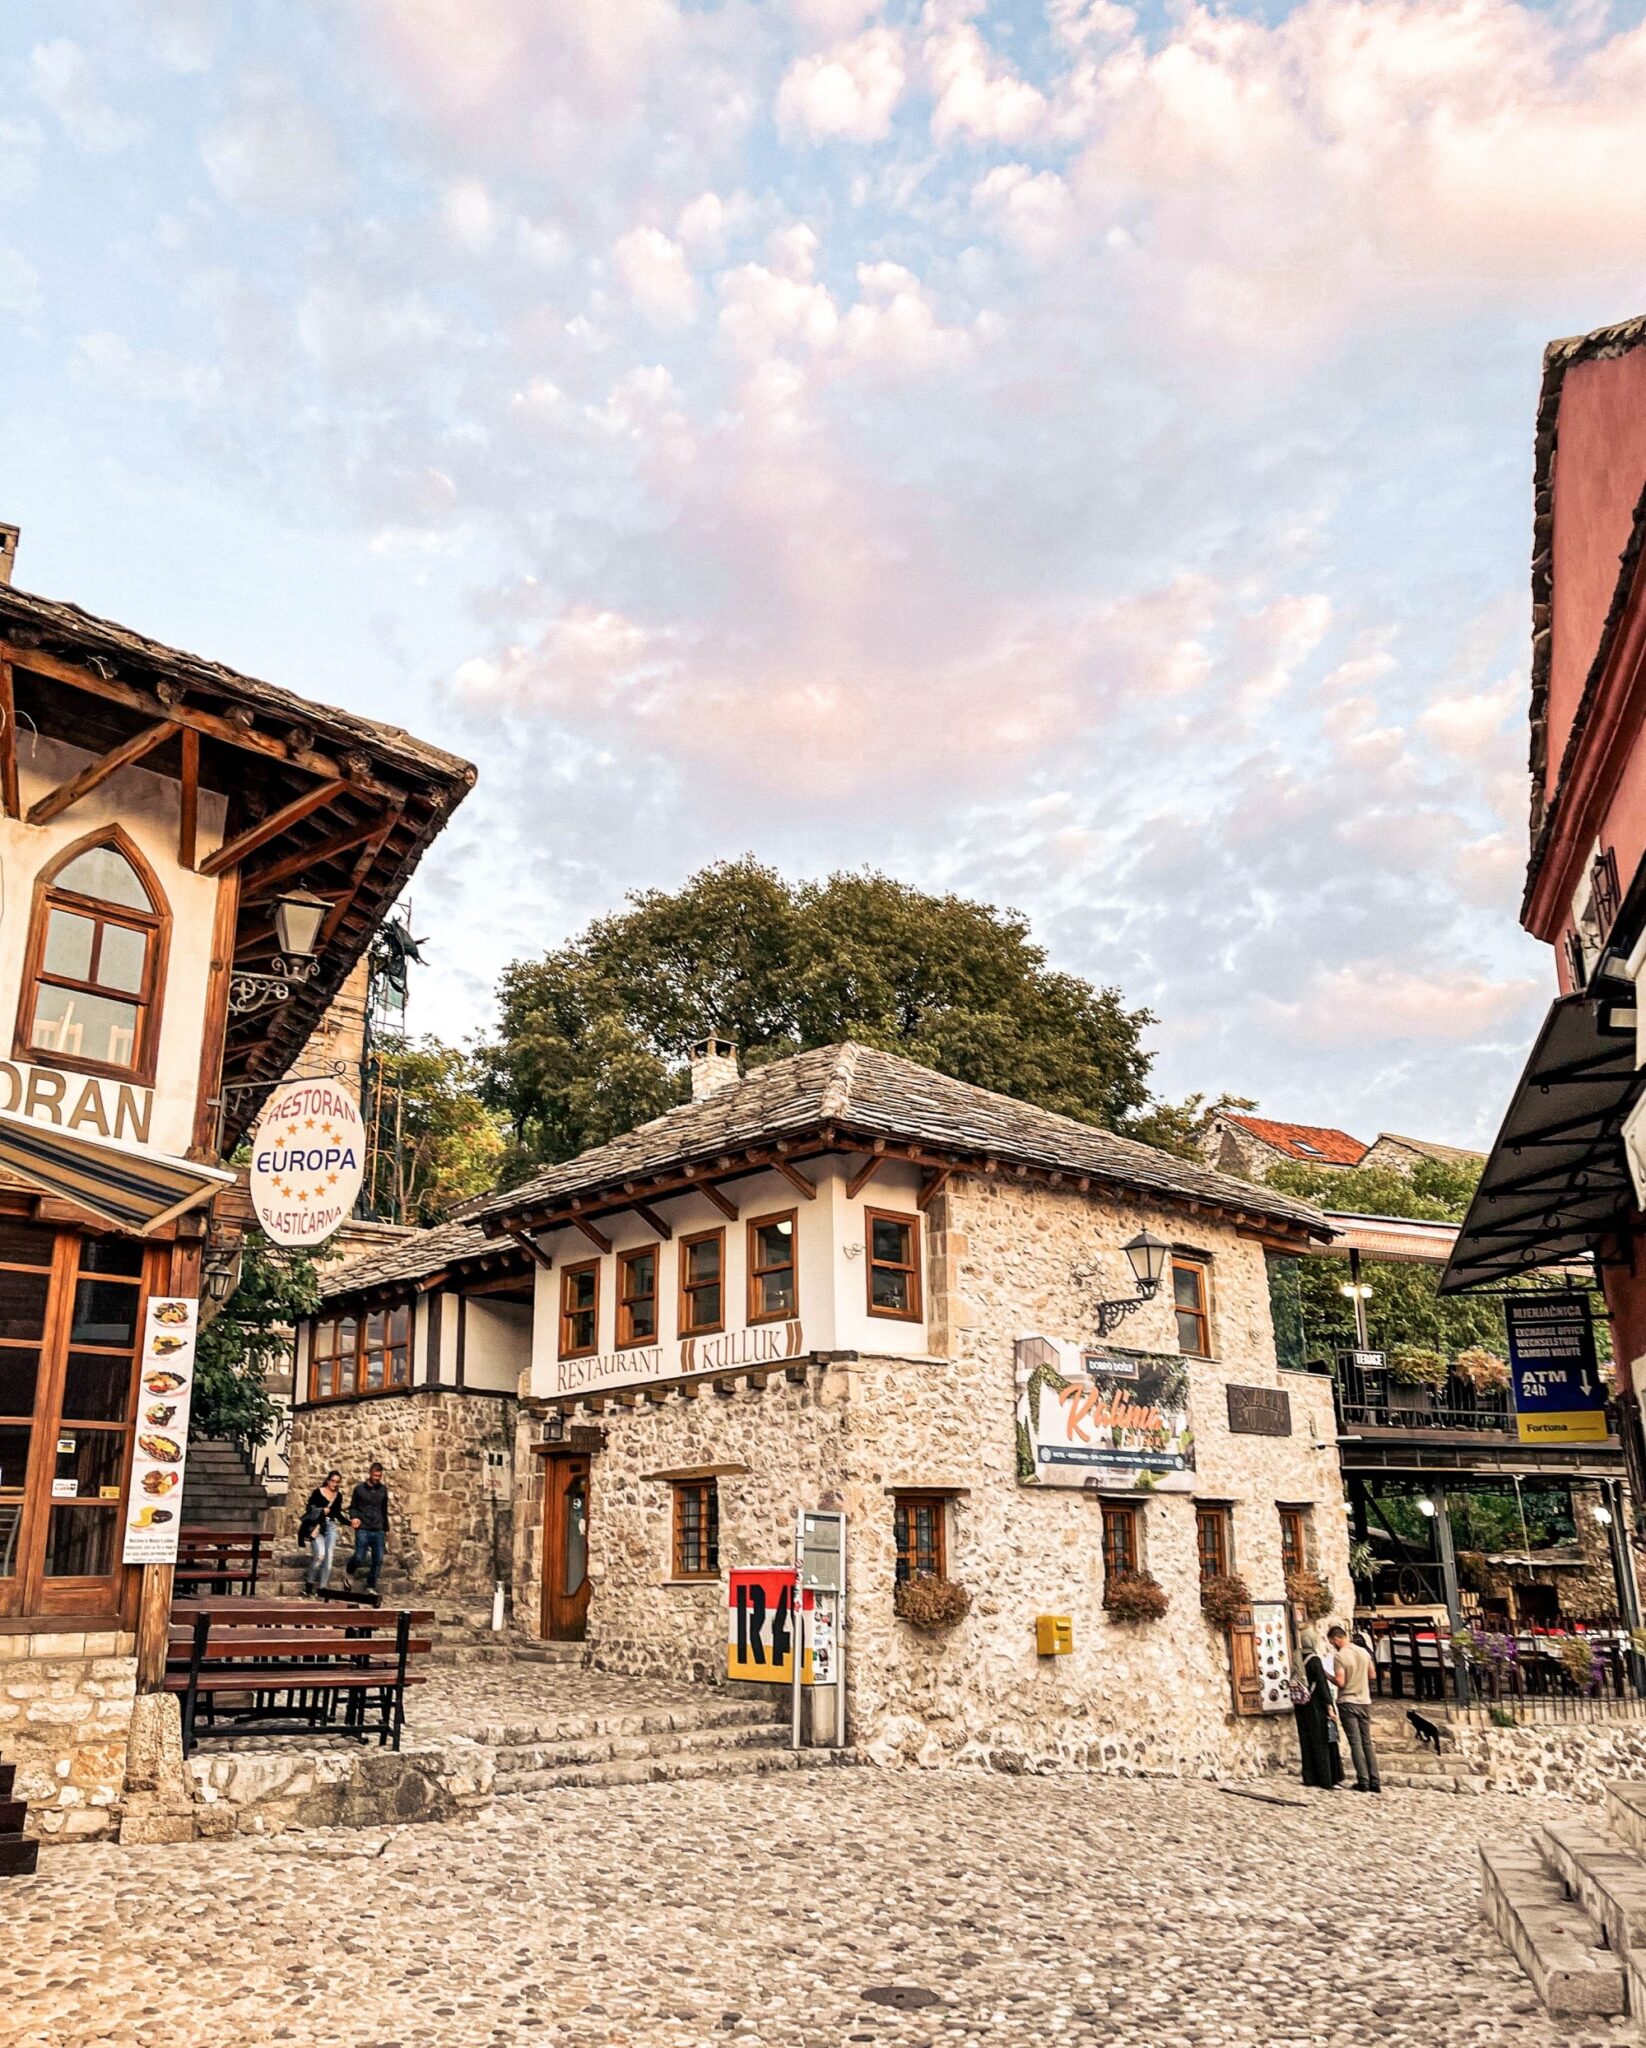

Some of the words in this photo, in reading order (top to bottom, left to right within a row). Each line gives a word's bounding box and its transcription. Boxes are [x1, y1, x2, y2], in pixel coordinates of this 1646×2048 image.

[267, 1089, 356, 1125] RESTORAN
[257, 1148, 357, 1173] EUROPA
[262, 1206, 342, 1235] SLASTIČARNA
[1515, 1327, 1556, 1337] EXCHANGE
[1558, 1326, 1585, 1335] OFFICE
[557, 1348, 664, 1392] RESTAURANT
[702, 1329, 782, 1370] KULLUK
[1089, 1360, 1113, 1371] DOBRO
[1521, 1370, 1568, 1383] ATM
[1522, 1384, 1547, 1397] 24h
[1526, 1424, 1569, 1433] Fortuna
